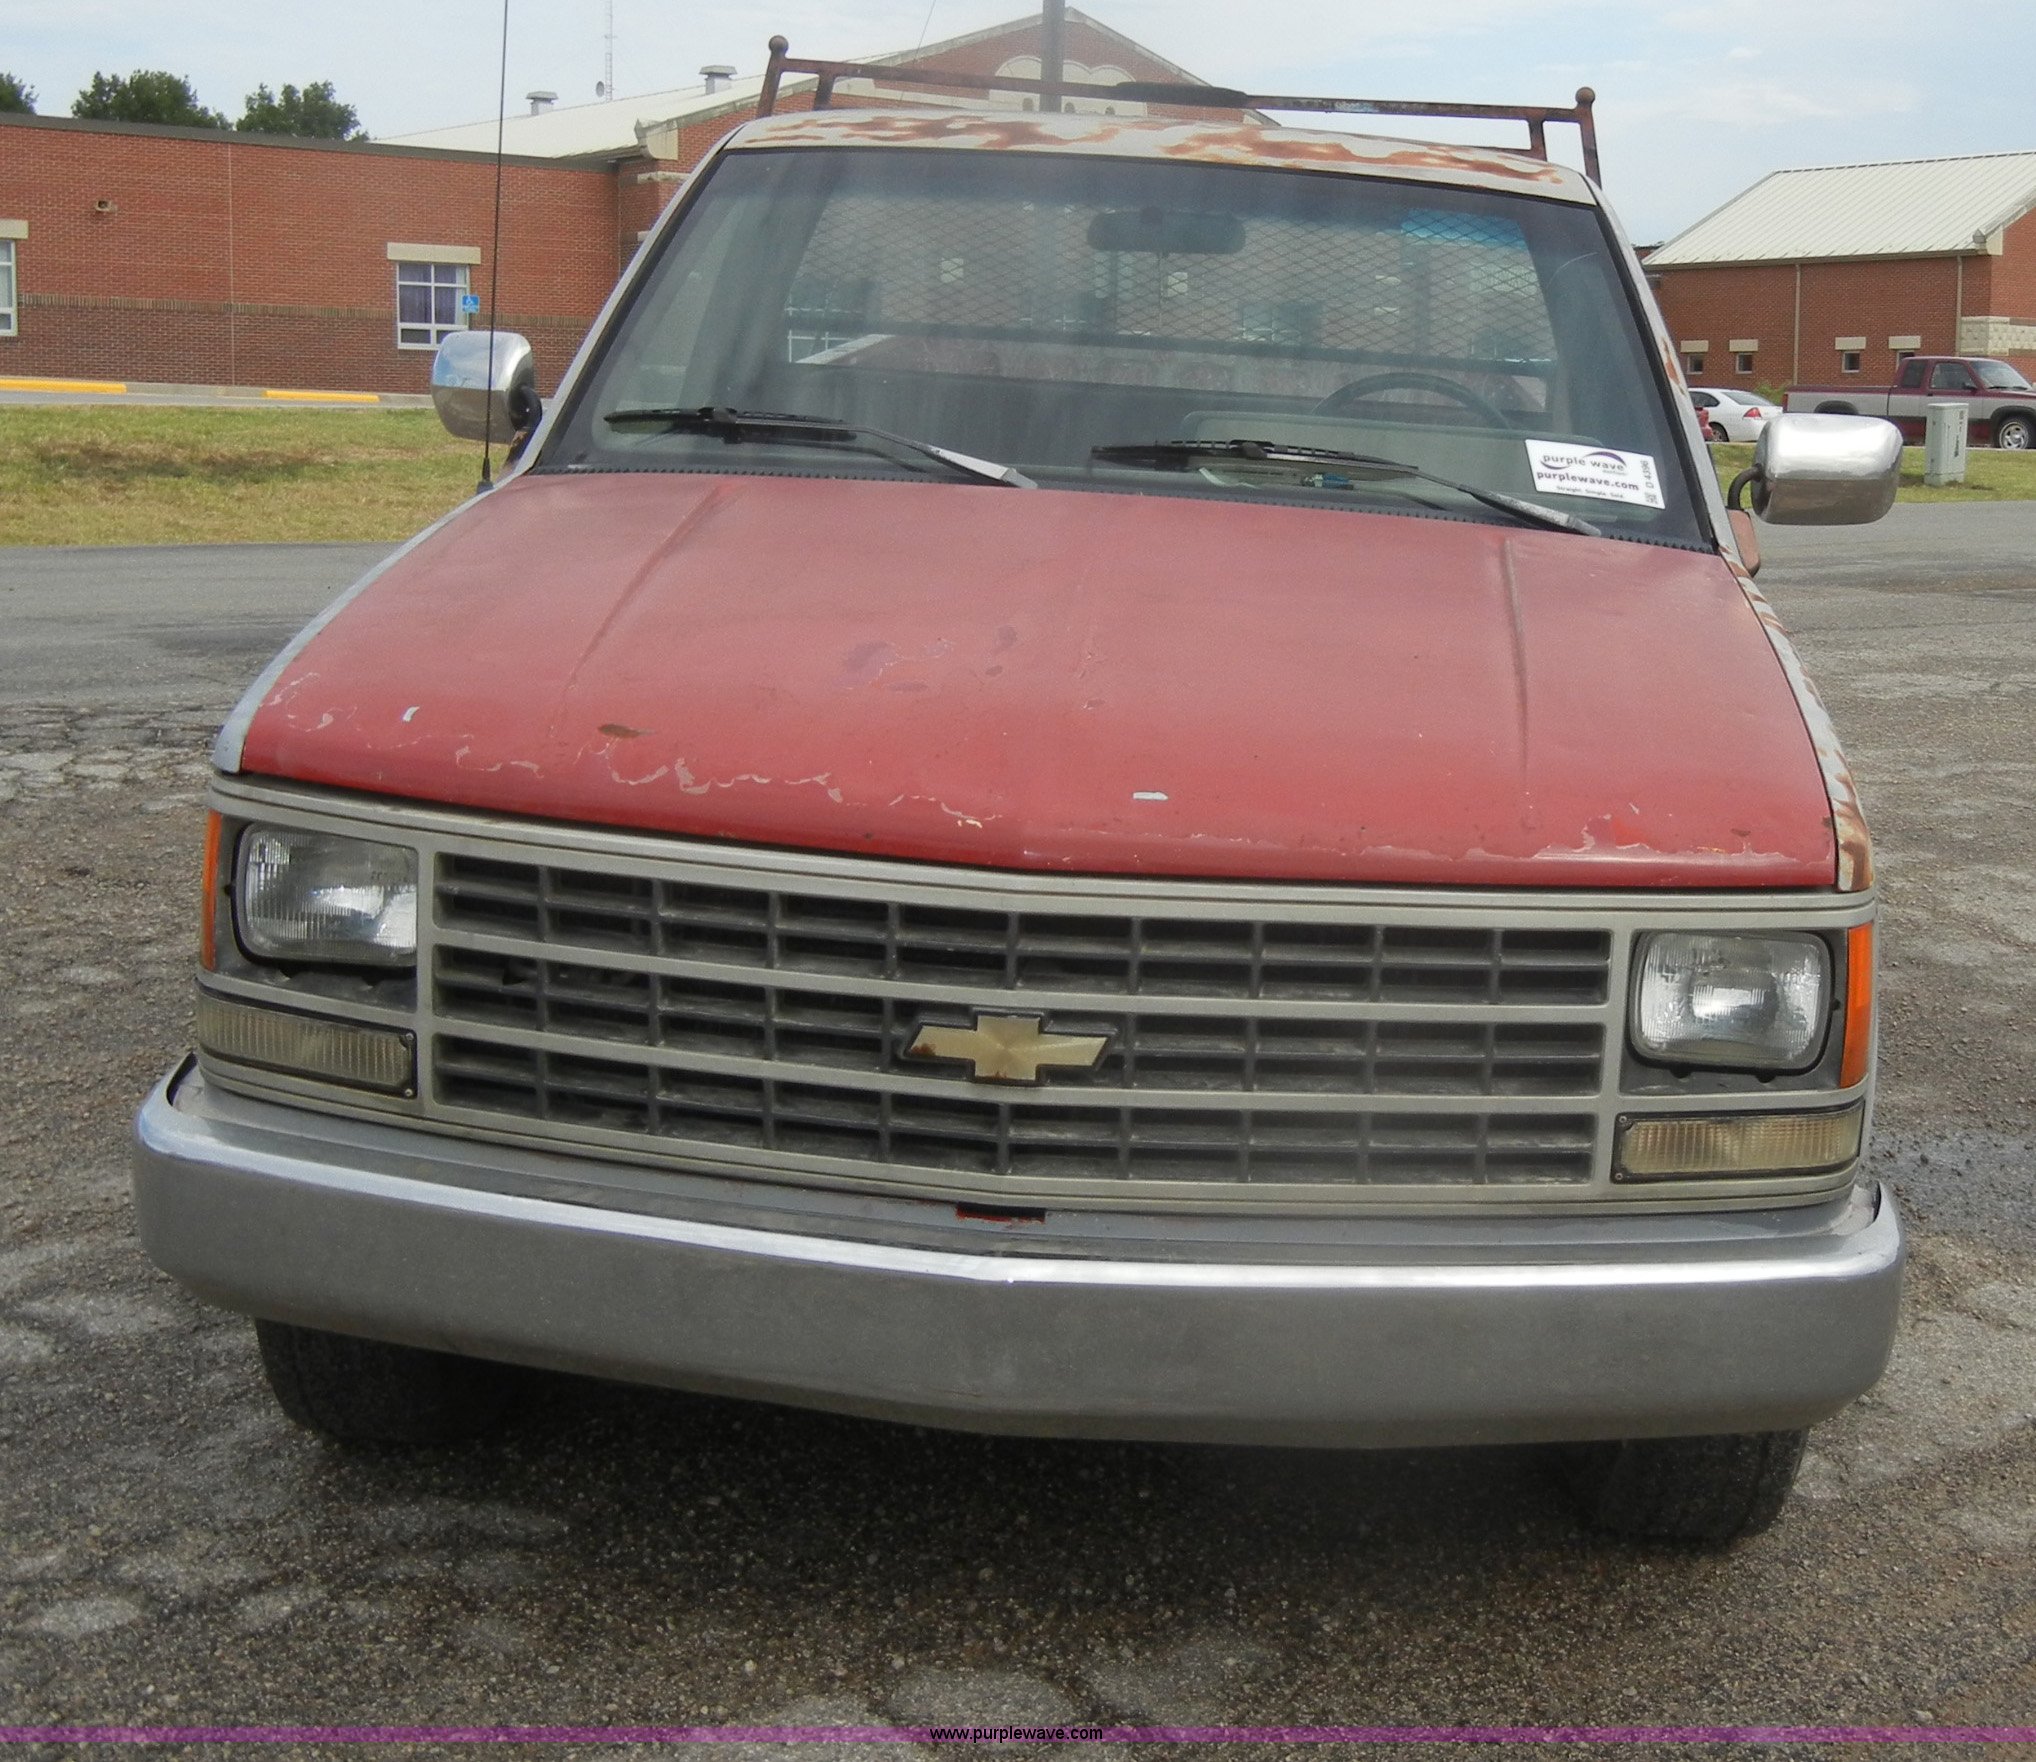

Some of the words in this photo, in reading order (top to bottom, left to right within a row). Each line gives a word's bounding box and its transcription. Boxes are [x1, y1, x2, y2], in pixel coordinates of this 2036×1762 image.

[1543, 454, 1586, 466] purple
[1590, 460, 1625, 472] wave
[1537, 471, 1640, 491] purplewave.com
